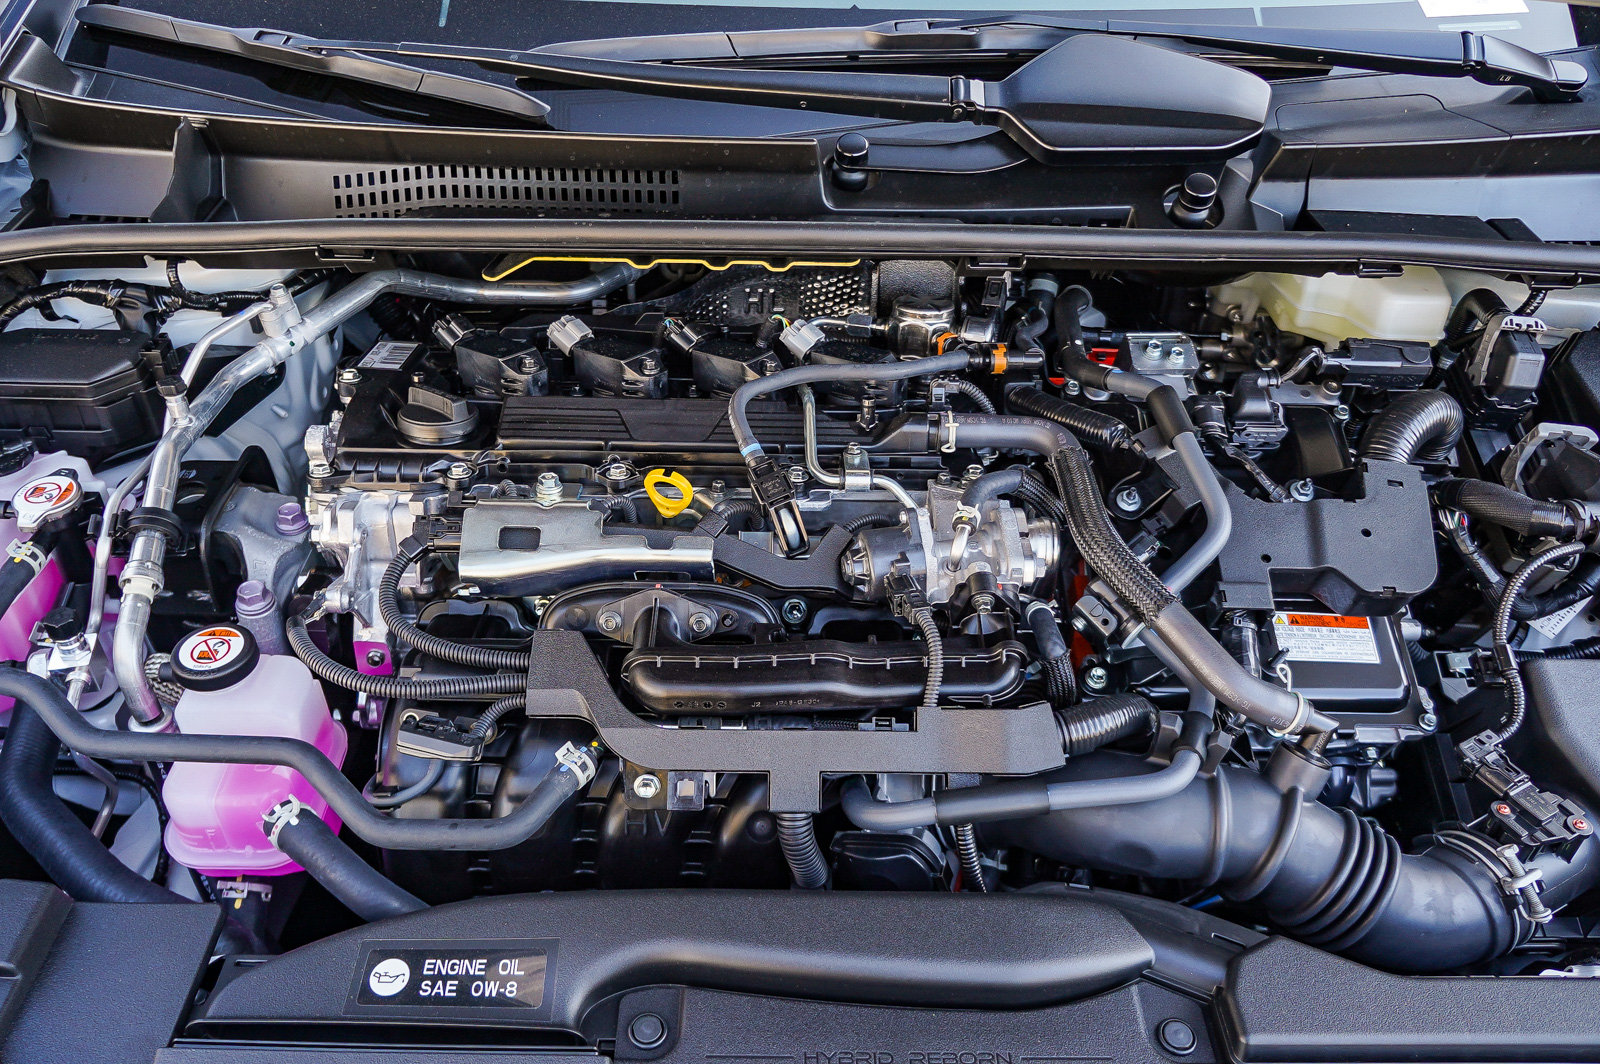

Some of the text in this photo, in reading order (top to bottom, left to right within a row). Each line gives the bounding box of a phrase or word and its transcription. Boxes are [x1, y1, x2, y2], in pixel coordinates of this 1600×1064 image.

[422, 959, 525, 976] ENGINE OIL
[419, 980, 518, 998] SAE 0W-8
[803, 1050, 1012, 1064] HYBRID REBORN
